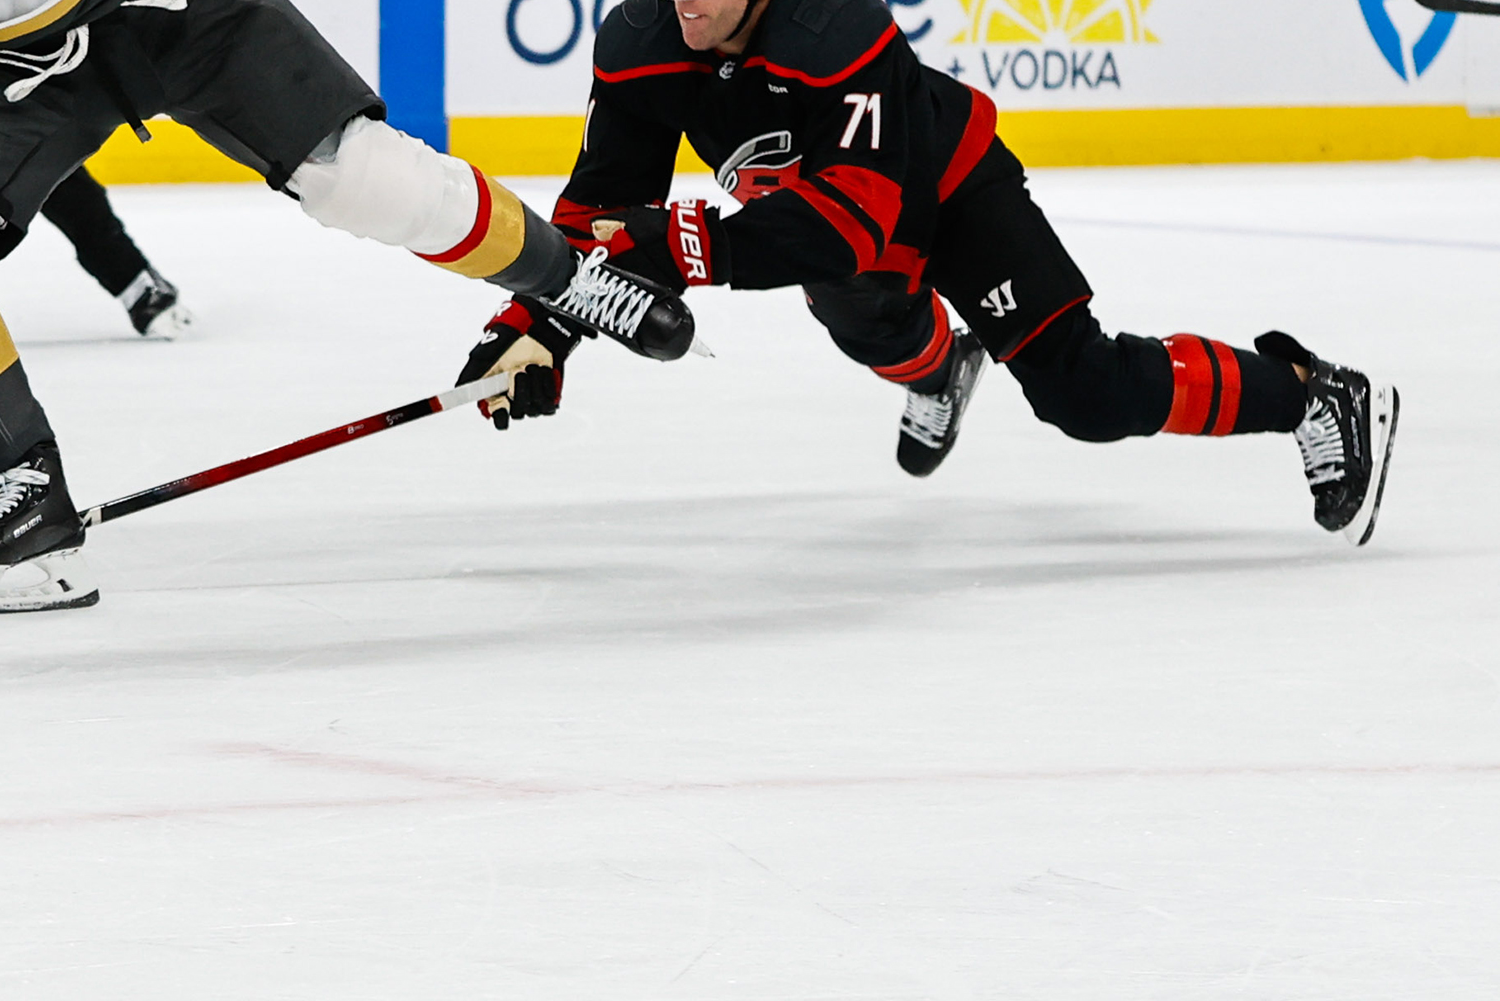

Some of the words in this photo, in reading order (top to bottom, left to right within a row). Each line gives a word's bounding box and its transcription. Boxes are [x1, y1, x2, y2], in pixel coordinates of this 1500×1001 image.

[980, 49, 1121, 90] VODKA
[838, 93, 883, 150] 71
[12, 513, 44, 540] BAUER
